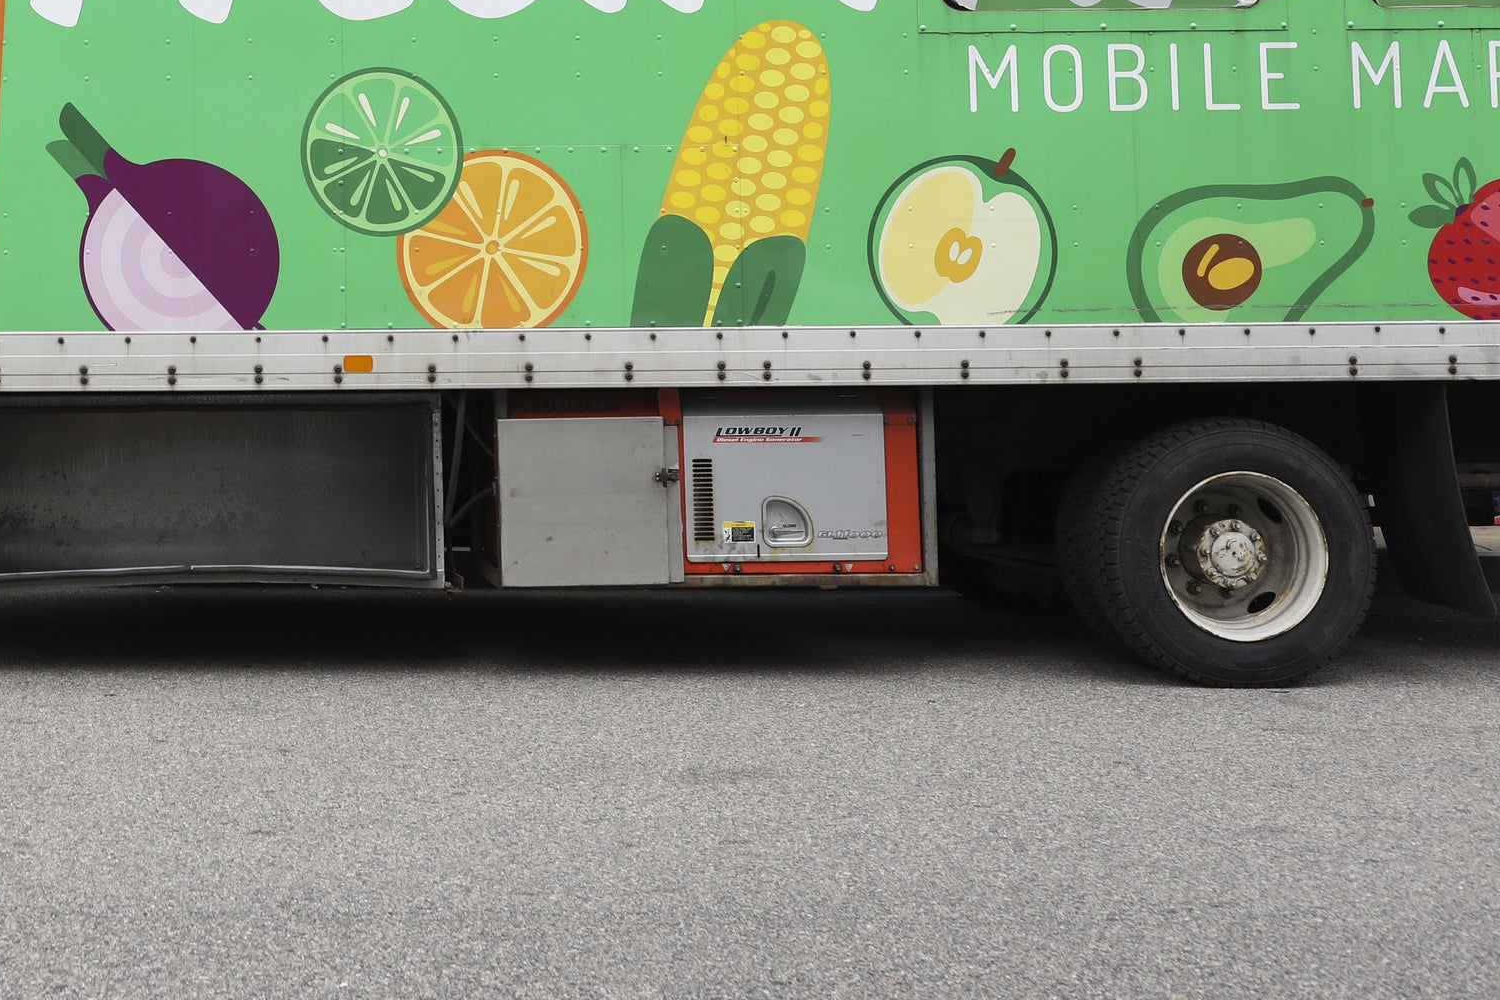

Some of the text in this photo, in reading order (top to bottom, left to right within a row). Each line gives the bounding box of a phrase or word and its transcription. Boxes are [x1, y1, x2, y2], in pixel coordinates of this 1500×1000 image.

[968, 40, 1301, 113] MOBILE
[520, 398, 617, 412] KUBOTA
[715, 426, 802, 437] LOWBOY II
